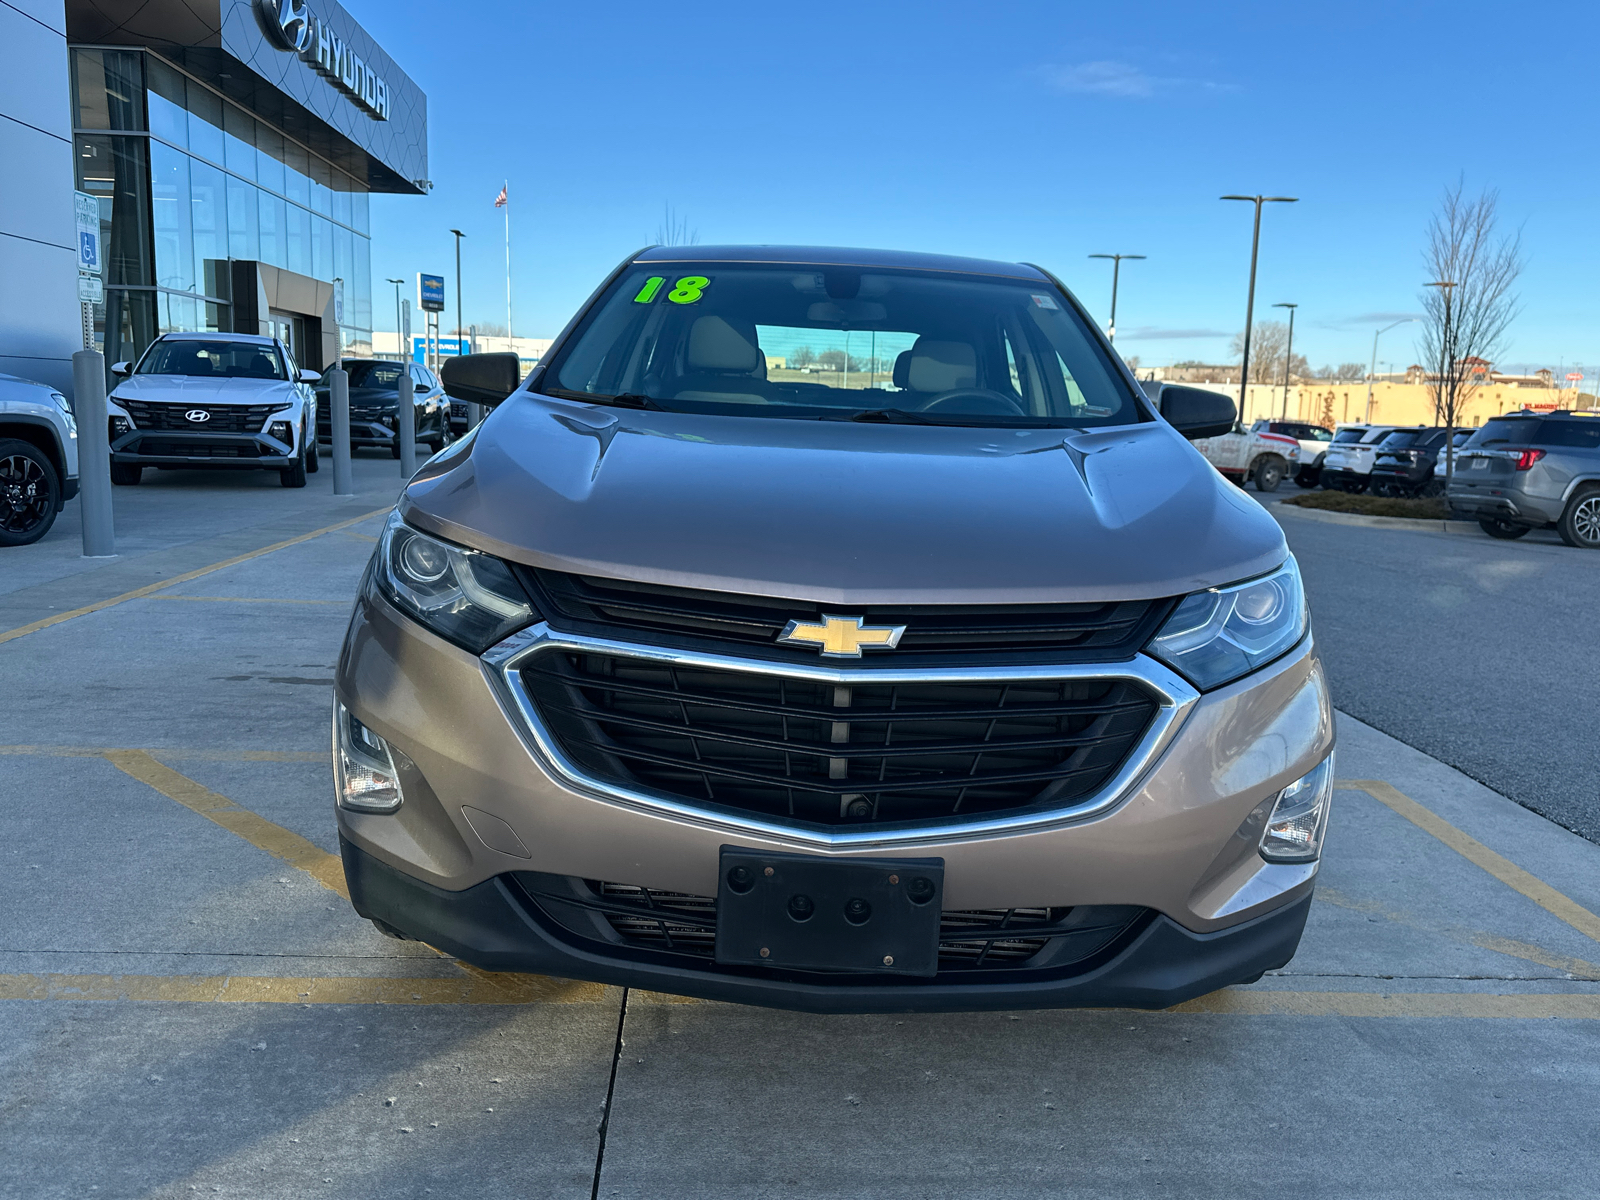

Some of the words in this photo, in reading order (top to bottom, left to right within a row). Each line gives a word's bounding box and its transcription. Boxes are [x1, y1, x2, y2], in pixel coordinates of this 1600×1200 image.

[315, 17, 390, 122] HYUNDAI
[76, 199, 96, 213] RESERVED
[77, 213, 97, 227] PARKING
[634, 275, 711, 304] 18
